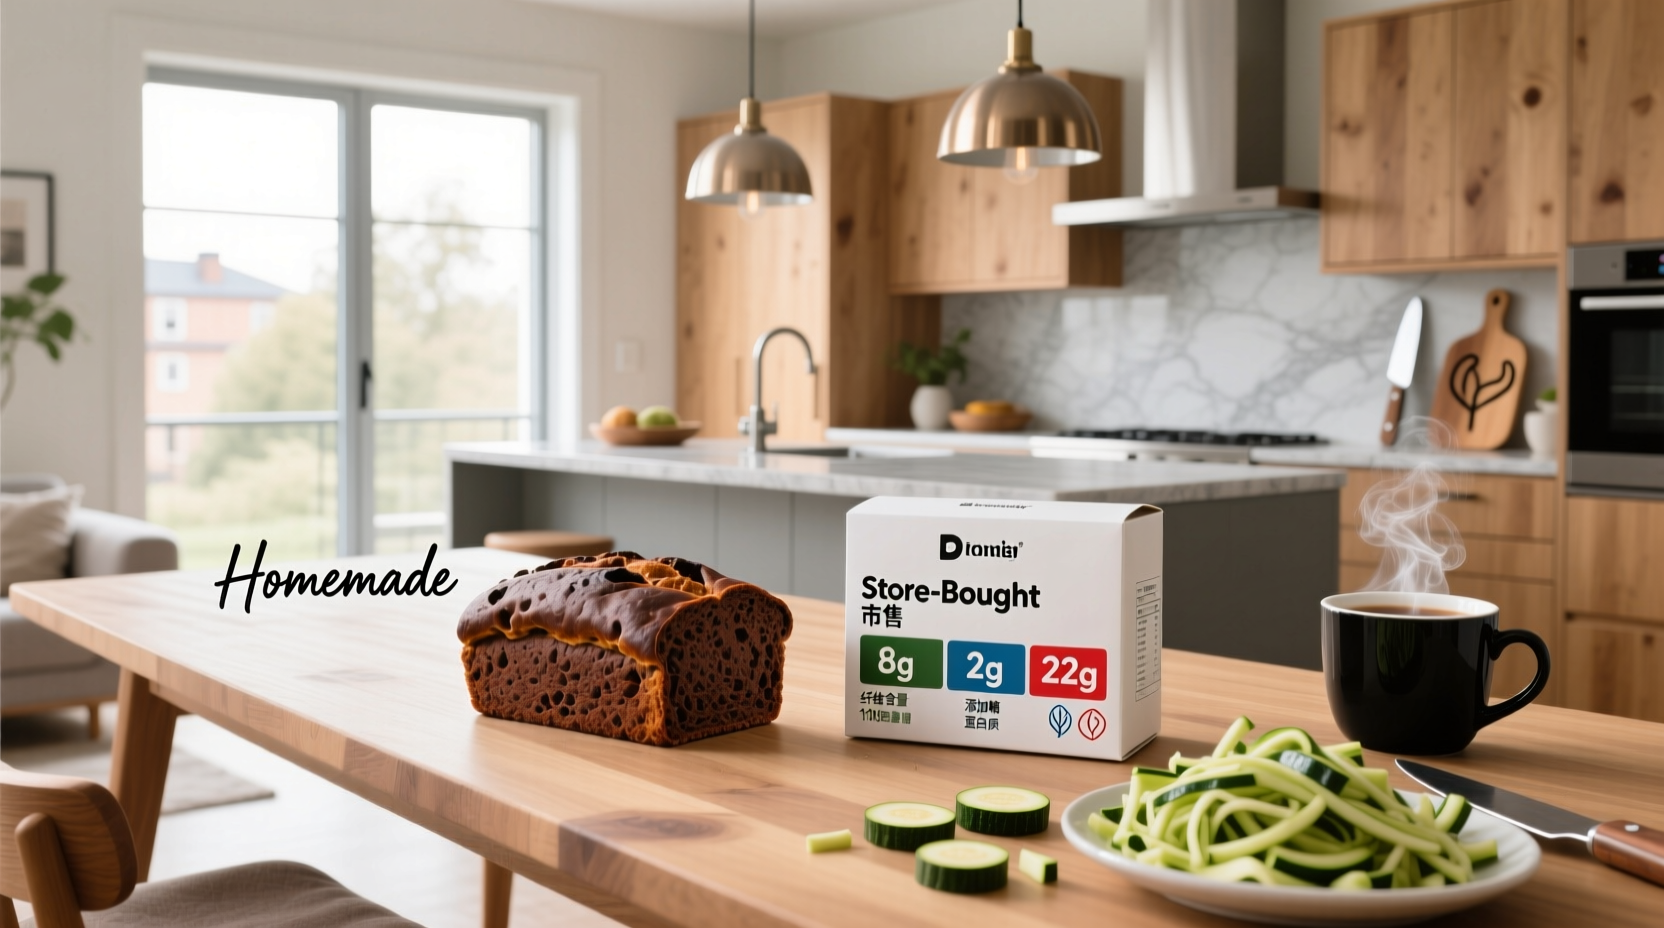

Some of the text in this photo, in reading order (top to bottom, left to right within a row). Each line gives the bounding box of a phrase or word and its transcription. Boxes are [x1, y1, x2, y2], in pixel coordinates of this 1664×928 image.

[862, 576, 1041, 613] Store-Bought
[862, 604, 903, 629] 市售
[877, 646, 914, 683] 8g
[966, 651, 1004, 688] 2g
[1041, 655, 1098, 694] 22g
